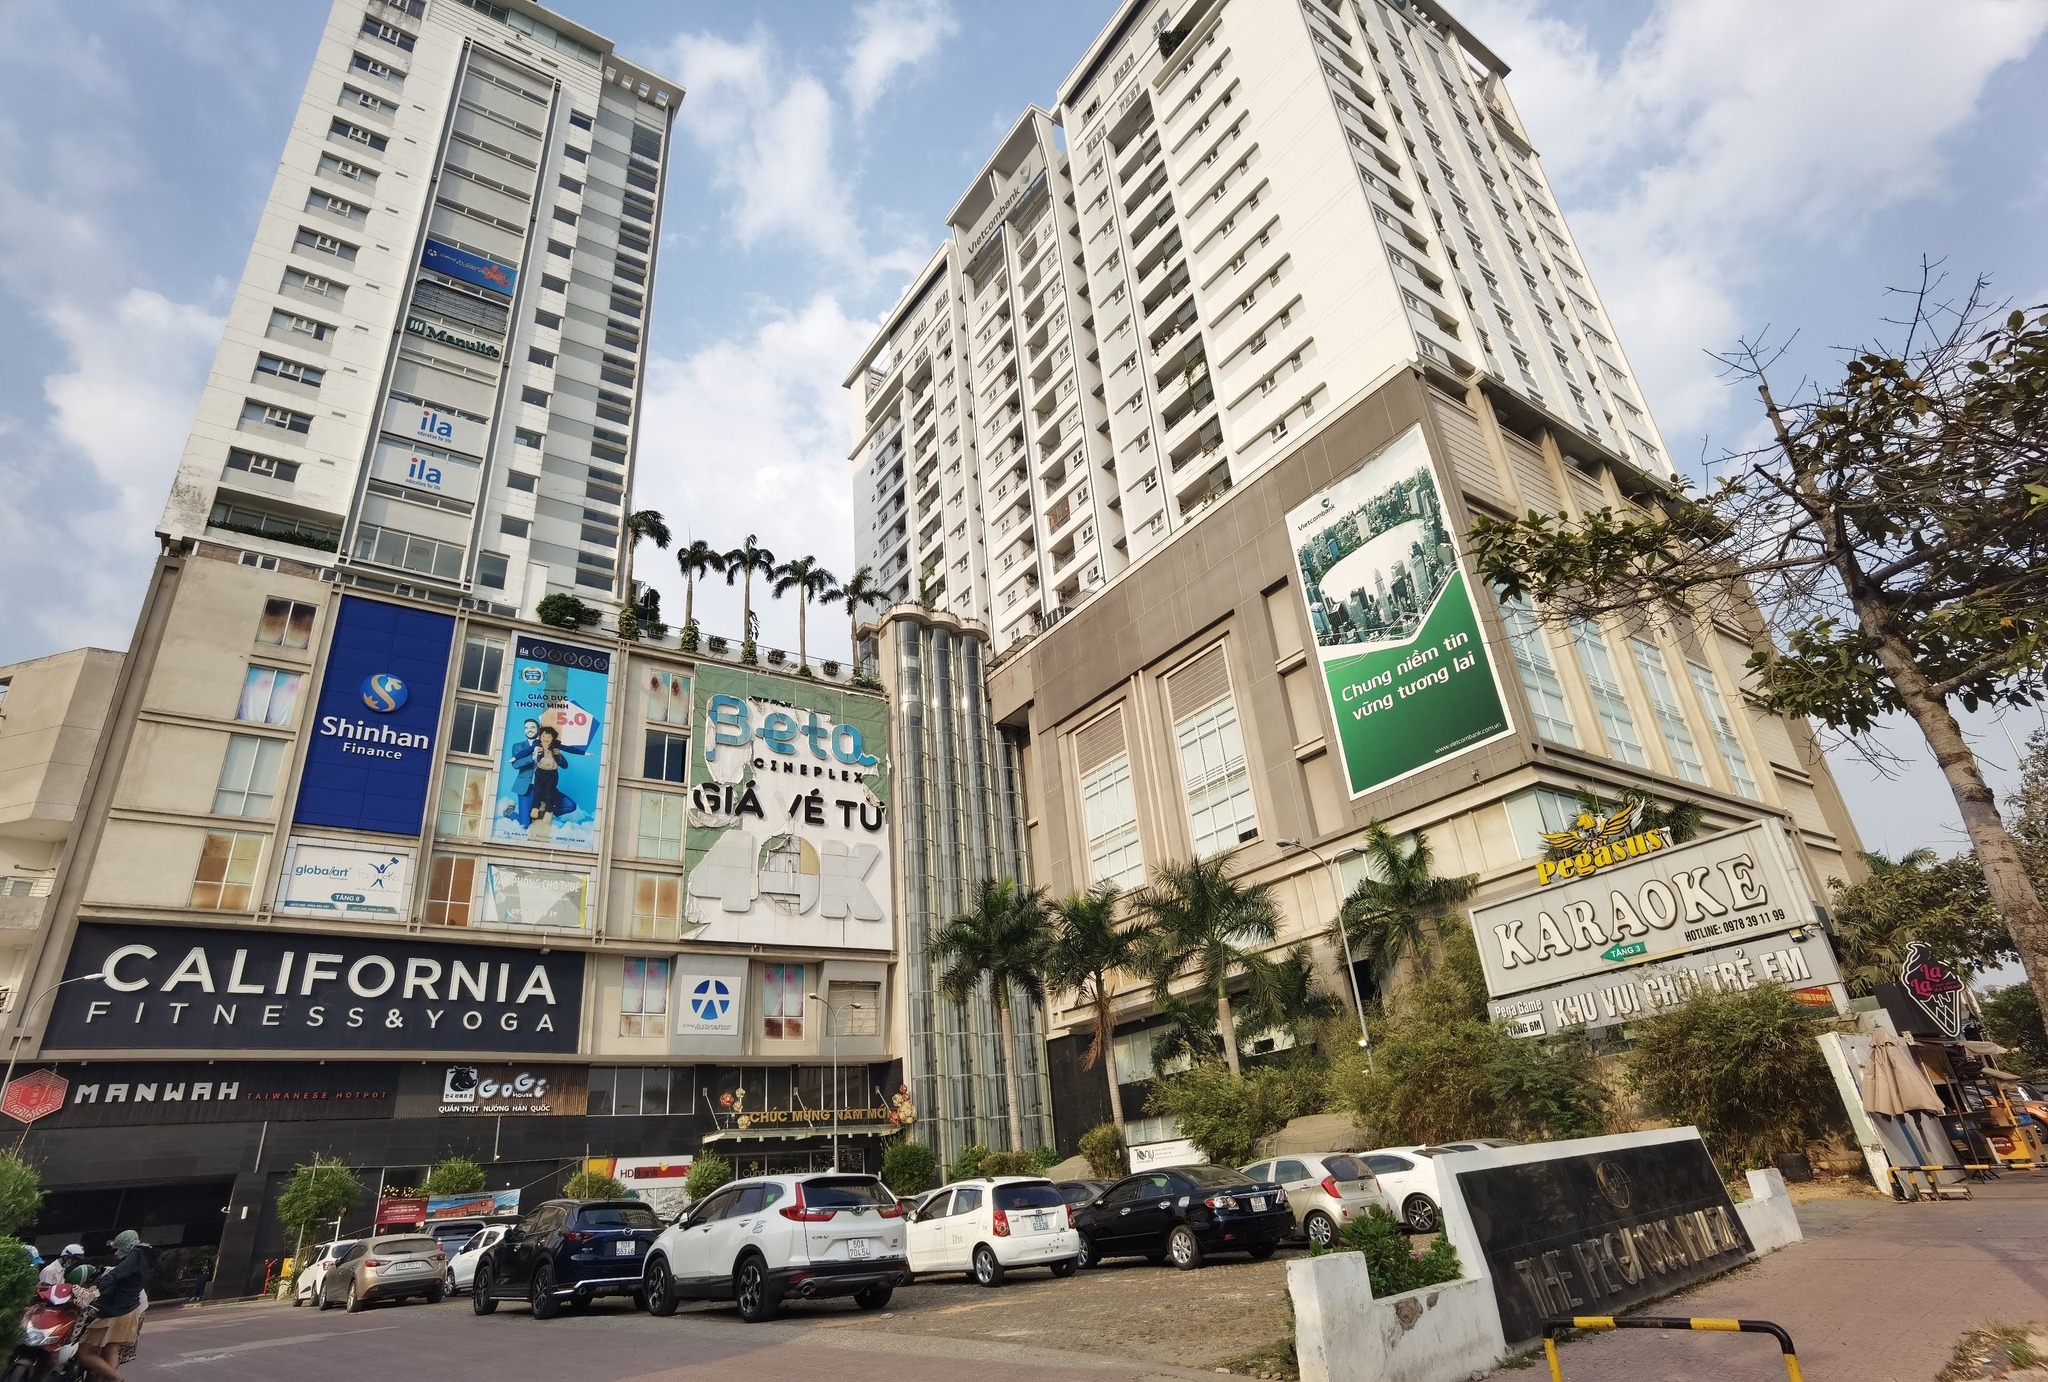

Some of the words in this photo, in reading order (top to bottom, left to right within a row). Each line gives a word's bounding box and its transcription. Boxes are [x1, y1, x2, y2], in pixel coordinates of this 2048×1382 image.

[968, 186, 1020, 254] Vietcombank
[427, 326, 500, 358] Manulife
[421, 411, 452, 437] ila
[409, 457, 441, 484] ila
[1298, 504, 1335, 531] Vietcombank
[1342, 670, 1392, 702] Chung
[1397, 646, 1439, 676] niềm
[1443, 632, 1469, 651] tin
[1352, 694, 1393, 720] vững
[1398, 667, 1449, 699] tương
[1453, 651, 1475, 673] lai
[556, 711, 587, 726] 5.0
[704, 694, 878, 766] Beta
[320, 716, 429, 749] Shinhan
[1435, 722, 1502, 754] www.vietcombank.com.vn
[343, 742, 402, 759] Finance
[753, 758, 863, 783] CINEPLEX
[542, 880, 558, 890] CHO
[560, 880, 580, 892] THUÊ
[690, 831, 882, 920] 40K
[1493, 854, 1768, 969] KARAOKE
[1684, 924, 1723, 943] HOTLINE:
[1723, 918, 1745, 935] 0978
[1747, 914, 1758, 928] 39
[1760, 912, 1771, 925] 11
[1773, 908, 1786, 922] 99
[103, 944, 557, 1004] CALIFORNIA
[1552, 992, 1598, 1027] KHU
[1600, 983, 1641, 1017] VUI
[1703, 948, 1757, 994] TRẺ
[1759, 946, 1811, 982] EM
[1920, 964, 1942, 982] La
[1910, 979, 1932, 996] La
[86, 1001, 364, 1028] FITNESS
[384, 1008, 404, 1029] &
[426, 1010, 555, 1032] YOGA
[1518, 999, 1542, 1014] Game
[1530, 1020, 1541, 1031] 6M
[74, 1082, 240, 1104] MANWAH
[246, 1091, 330, 1101] TAIWANESE
[335, 1090, 388, 1100] HOTPOT
[439, 1104, 460, 1113] QUÁN
[483, 1104, 509, 1112] NƯỚNG
[530, 1104, 551, 1112] QUỐC
[750, 1107, 788, 1122] CHÚC
